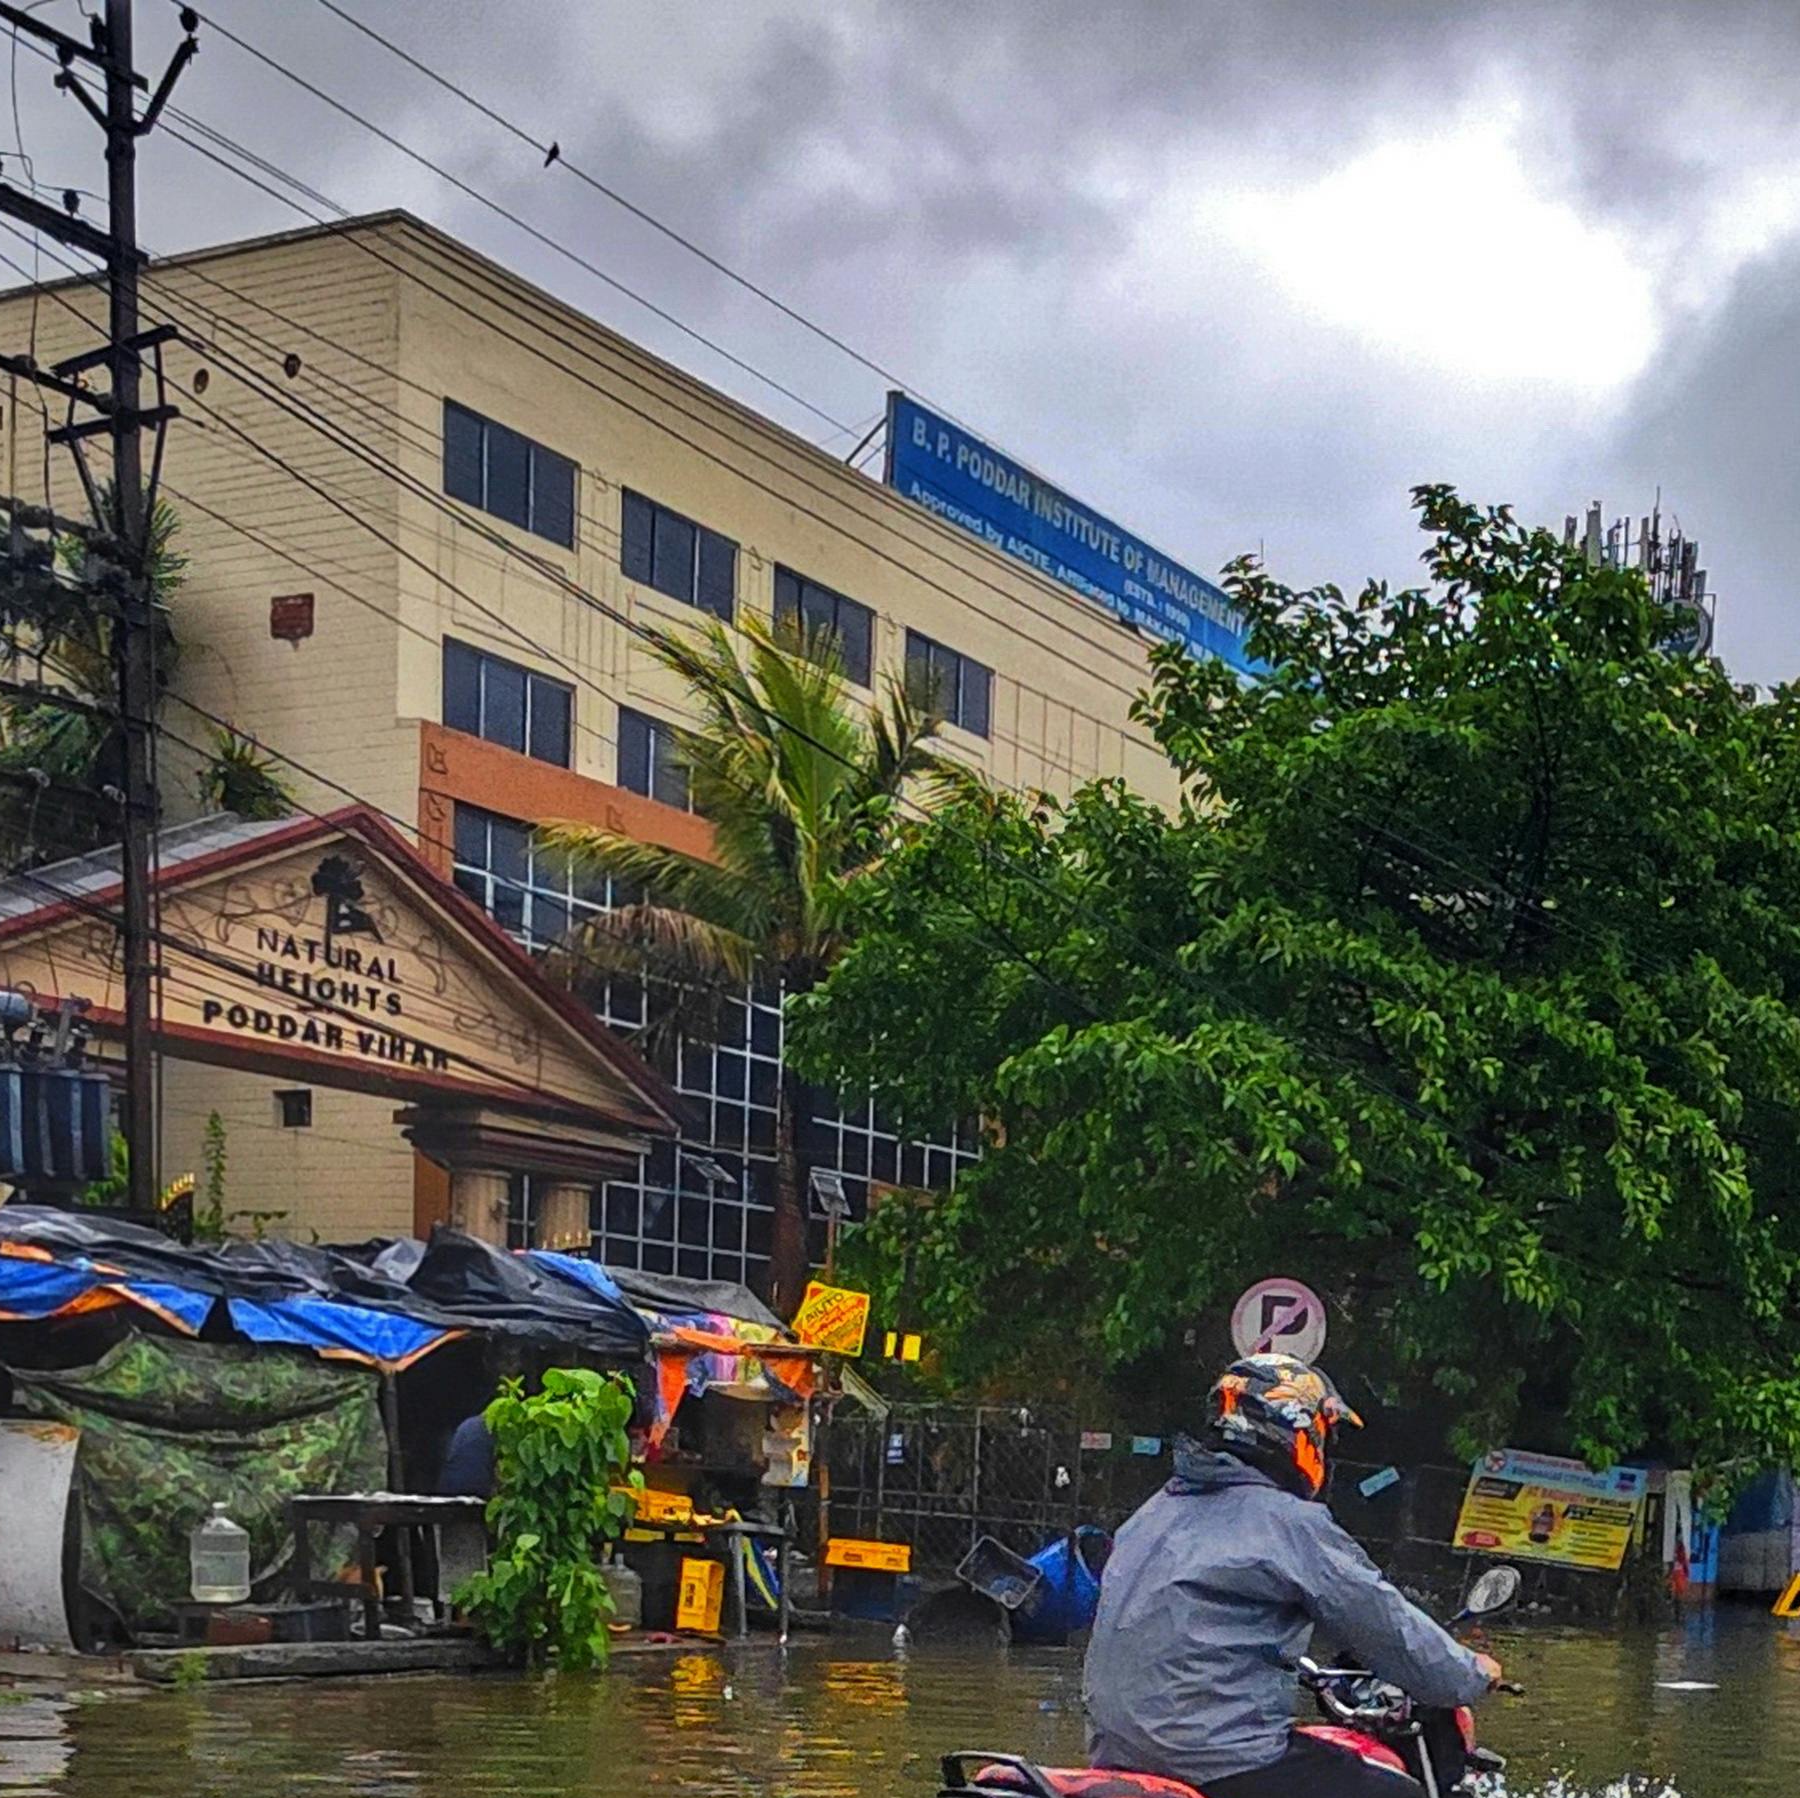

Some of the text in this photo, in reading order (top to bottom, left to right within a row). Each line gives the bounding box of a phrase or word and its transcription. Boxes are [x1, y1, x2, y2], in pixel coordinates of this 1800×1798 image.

[913, 417, 1246, 636] B. P. PODDAR INSTITUTE OF MANAGEMENT
[257, 927, 402, 983] NATURAL
[257, 962, 401, 1015] HEIGHTS
[203, 1000, 449, 1070] PODDAR VIHAR
